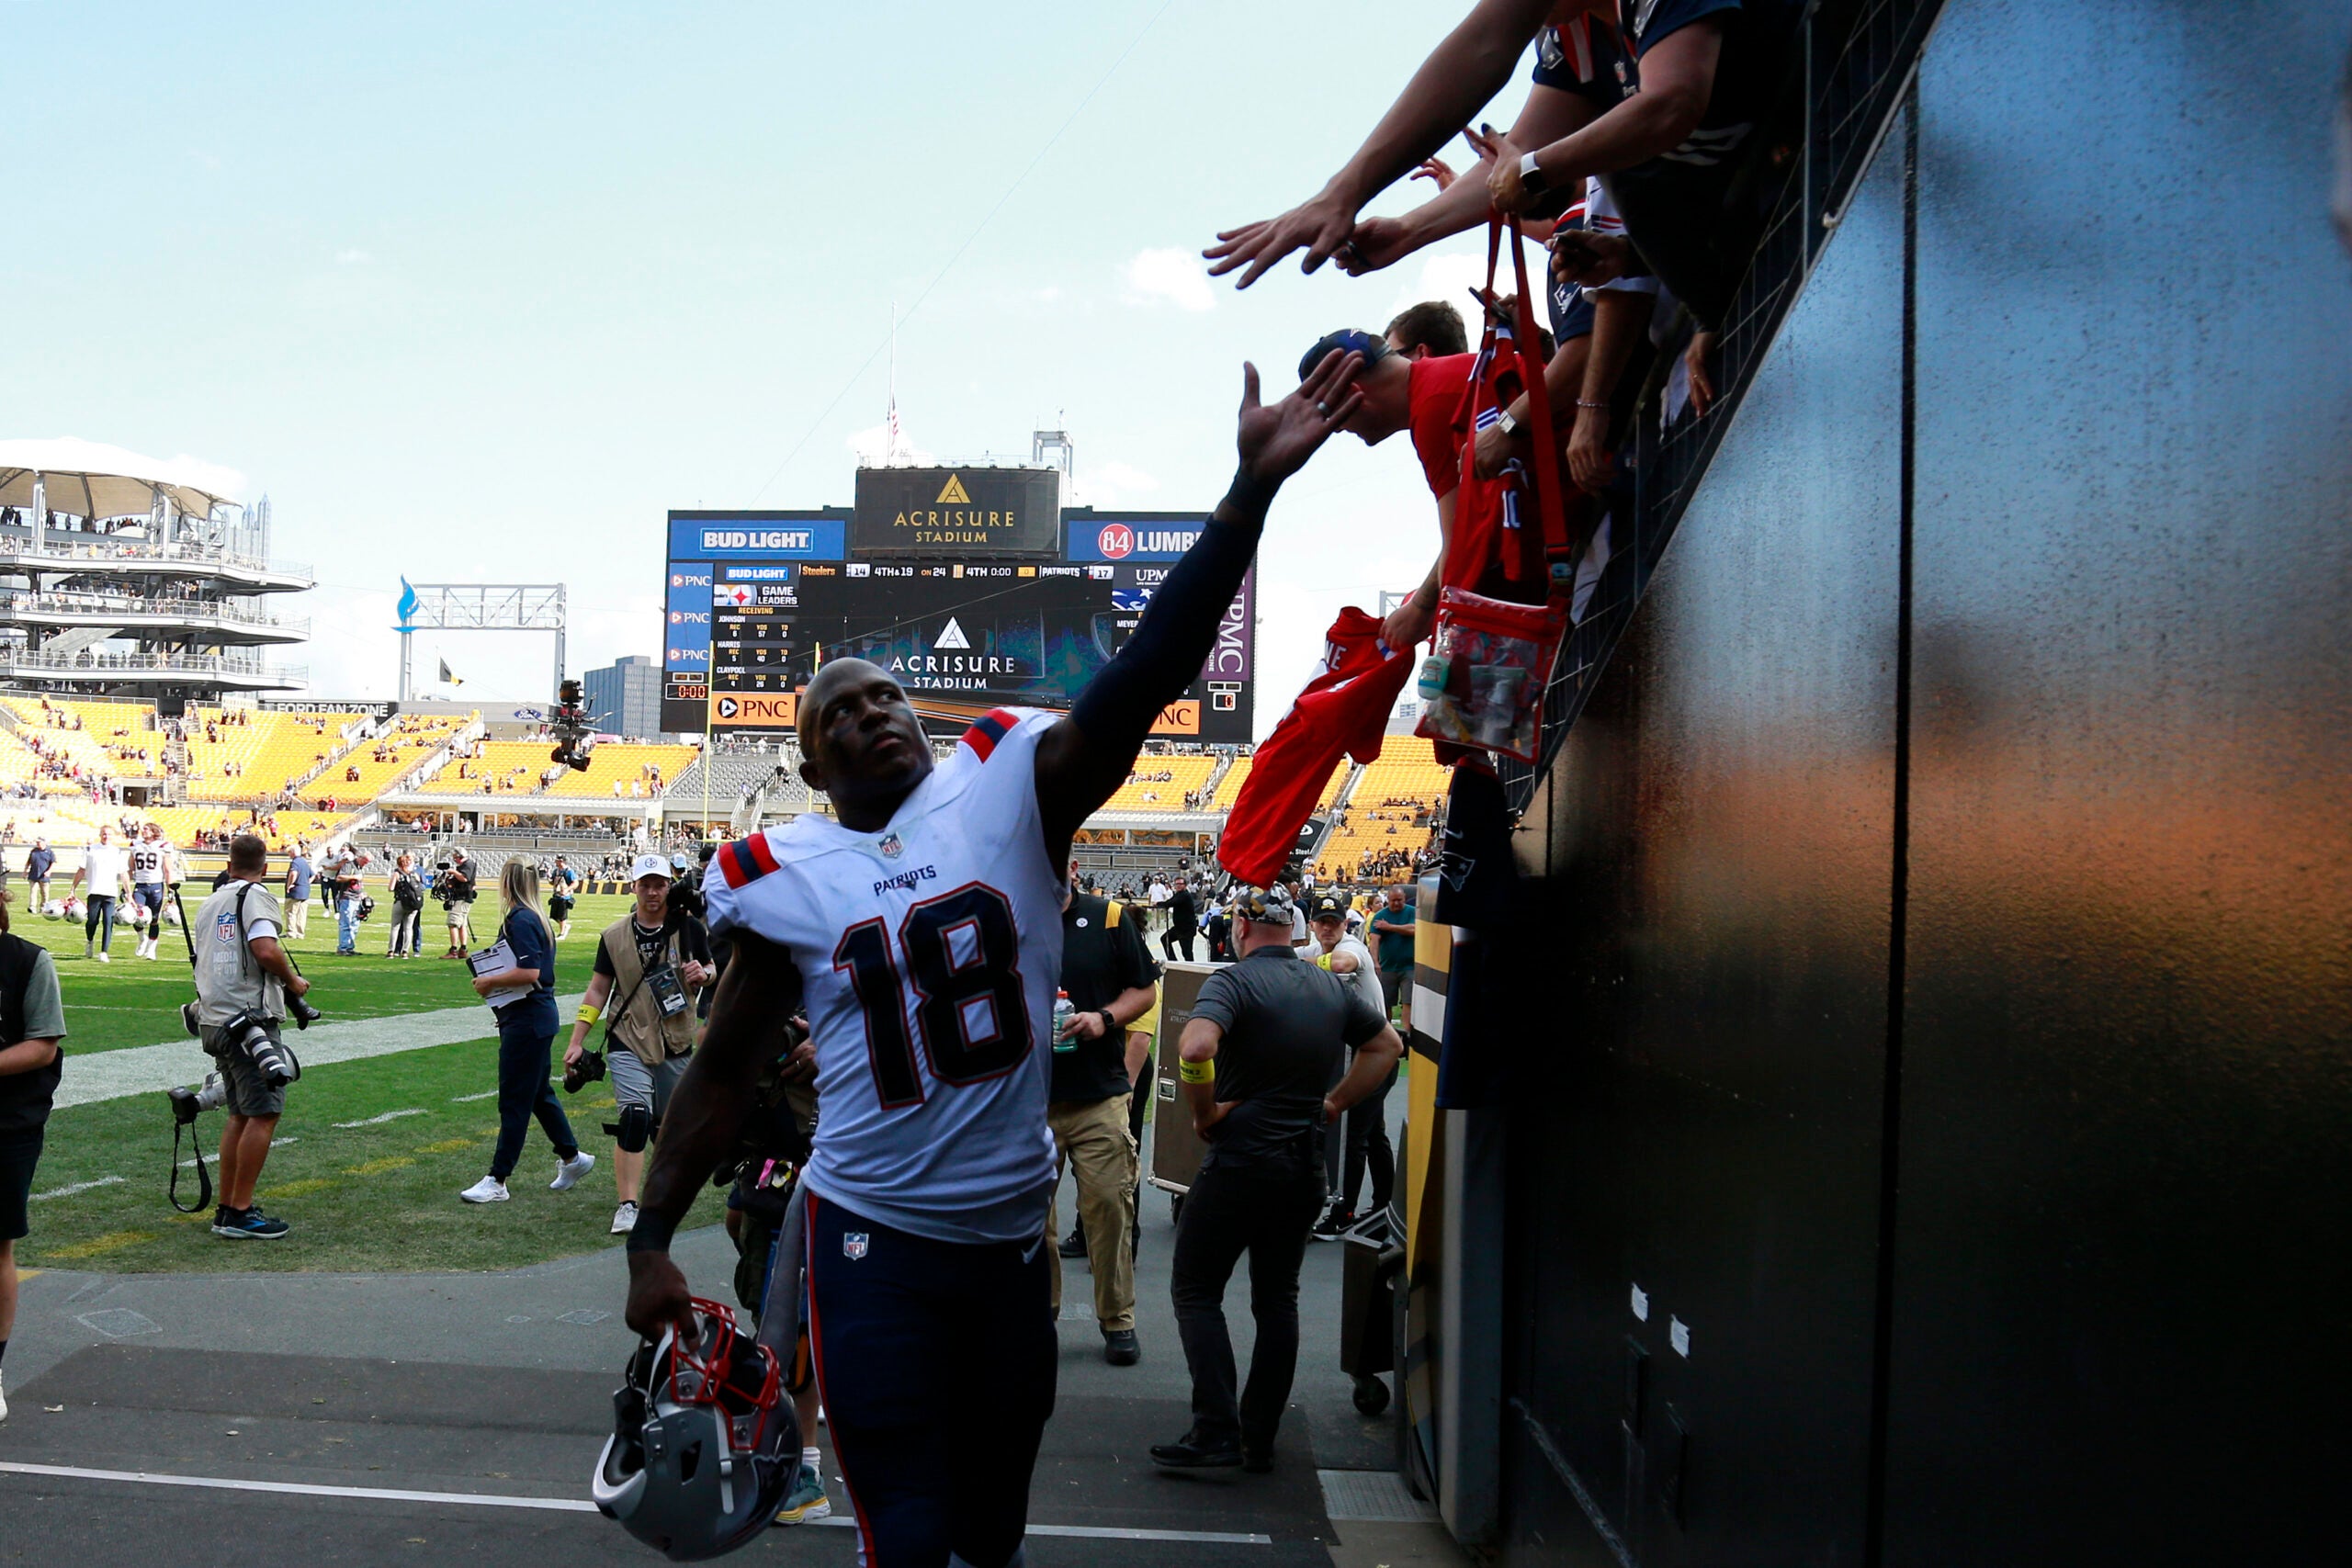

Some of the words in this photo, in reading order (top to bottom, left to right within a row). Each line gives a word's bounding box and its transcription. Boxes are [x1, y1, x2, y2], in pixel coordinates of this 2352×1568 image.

[894, 511, 1014, 526] ACRISURE
[704, 532, 747, 547] BUD
[749, 532, 809, 547] LIGHT
[916, 532, 988, 543] STADIUM
[1102, 531, 1129, 551] 84
[1136, 531, 1203, 552] LUMB
[728, 570, 752, 578] BUD
[753, 570, 786, 578] LIGHT
[802, 566, 836, 576] Steelers
[854, 568, 866, 576] 14
[933, 567, 946, 577] 24
[967, 567, 988, 577] 4TH
[990, 567, 1012, 577] 0:00
[1043, 567, 1080, 578] PATRIOTS
[1097, 570, 1109, 578] 17
[1136, 569, 1170, 581] UPM
[684, 576, 711, 586] PNC
[762, 586, 793, 595] GAME
[758, 596, 797, 604] LEADERS
[426, 598, 565, 628] PEOPLES
[684, 613, 710, 624] PNC
[1218, 577, 1245, 673] PMC
[682, 649, 708, 660] PNC
[717, 666, 746, 674] CLAYPOOL
[890, 656, 1014, 673] ACRISURE
[913, 677, 988, 690] STADIUM
[678, 685, 706, 698] 0:00
[277, 703, 315, 714] FORD
[318, 704, 346, 714] FAN
[349, 705, 389, 716] ZONE
[741, 701, 788, 717] PNC
[1159, 708, 1192, 726] NC
[883, 842, 901, 853] NFL
[135, 852, 157, 870] 69
[873, 864, 937, 897] PATRIOTS
[219, 924, 234, 940] NFL
[832, 880, 1035, 1111] 18
[848, 1244, 865, 1255] NFL
